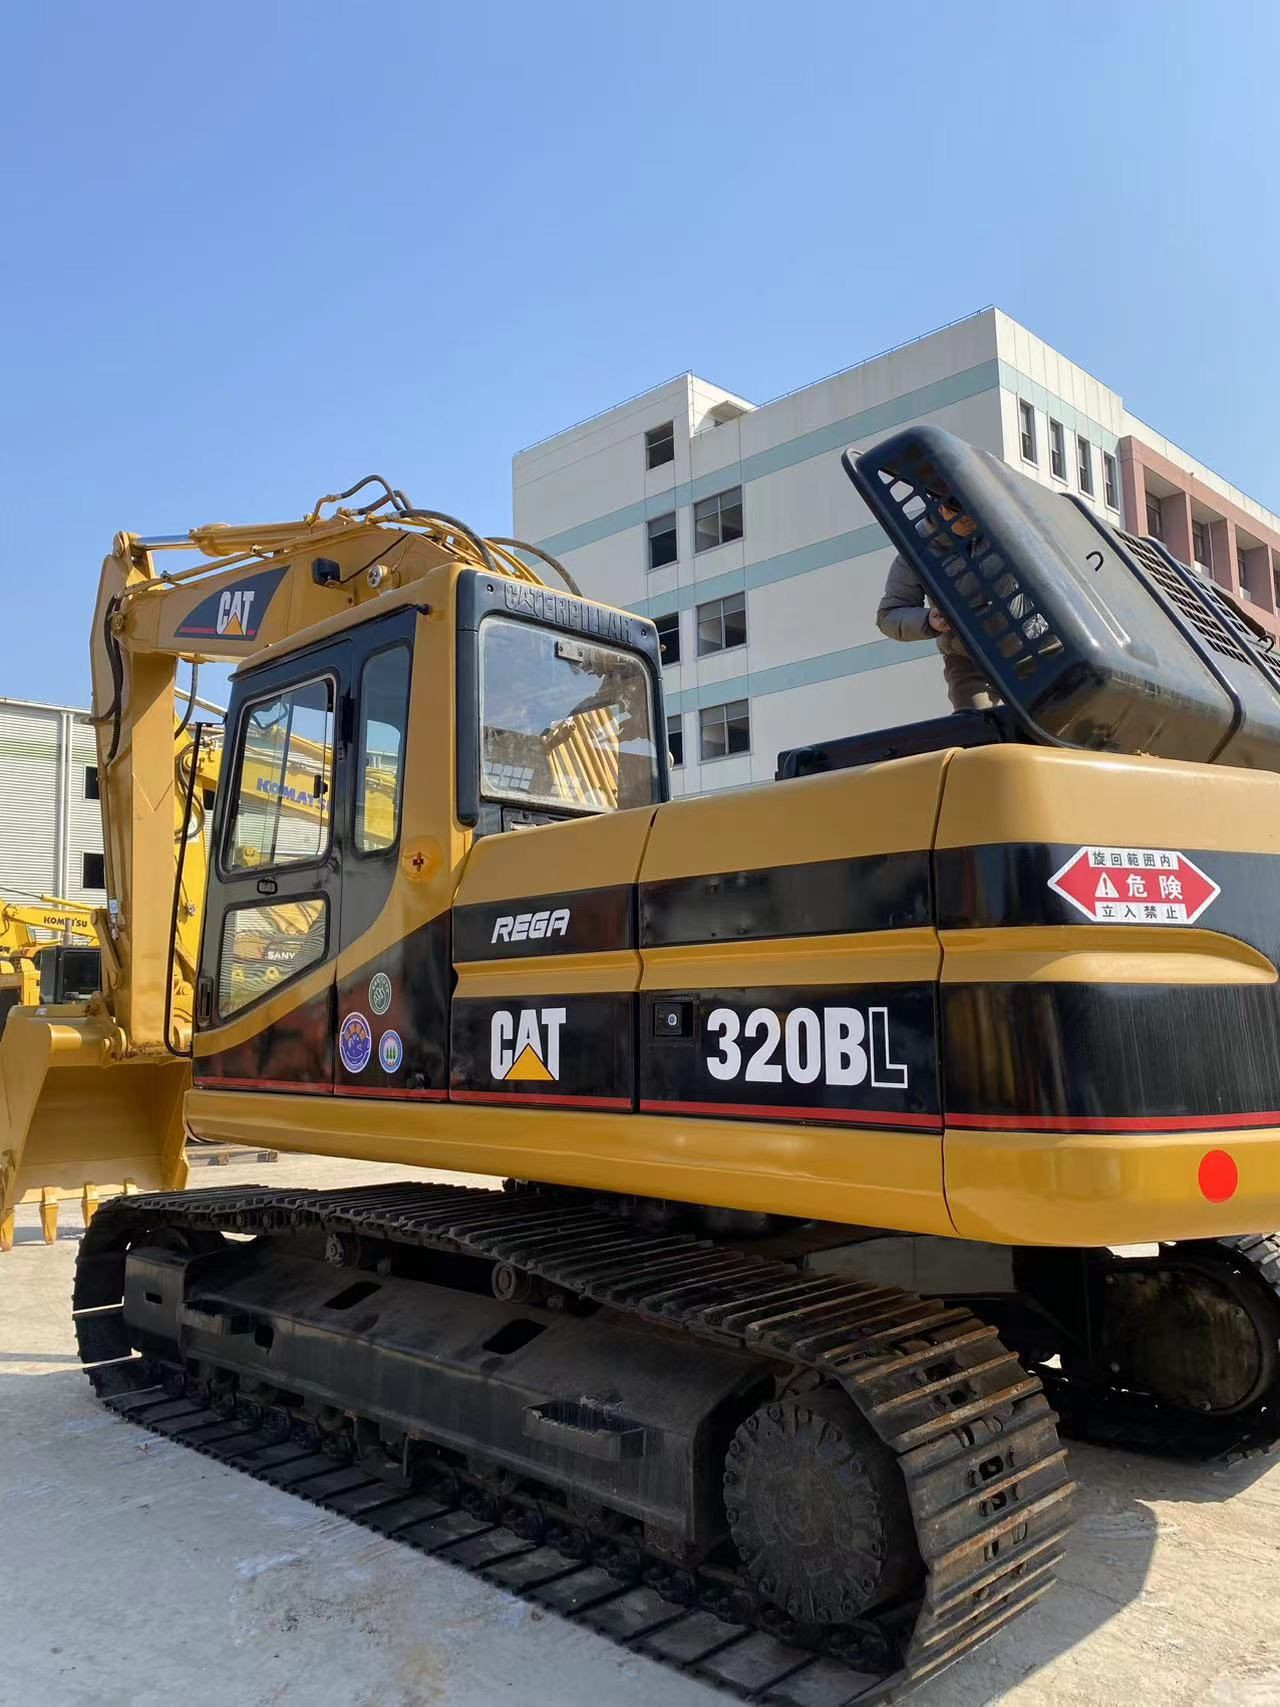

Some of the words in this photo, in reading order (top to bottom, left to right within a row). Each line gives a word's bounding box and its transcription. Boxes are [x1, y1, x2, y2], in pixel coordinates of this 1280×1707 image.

[216, 591, 255, 635] CAT
[504, 583, 633, 644] CATERPILLAR
[1093, 851, 1171, 867] 旋回範囲内
[1126, 873, 1183, 900] 危険
[43, 916, 88, 928] KOMTSU
[490, 908, 571, 944] REGA
[1102, 905, 1178, 920] 立入禁止
[267, 951, 296, 960] SANY
[490, 1007, 567, 1081] CAT
